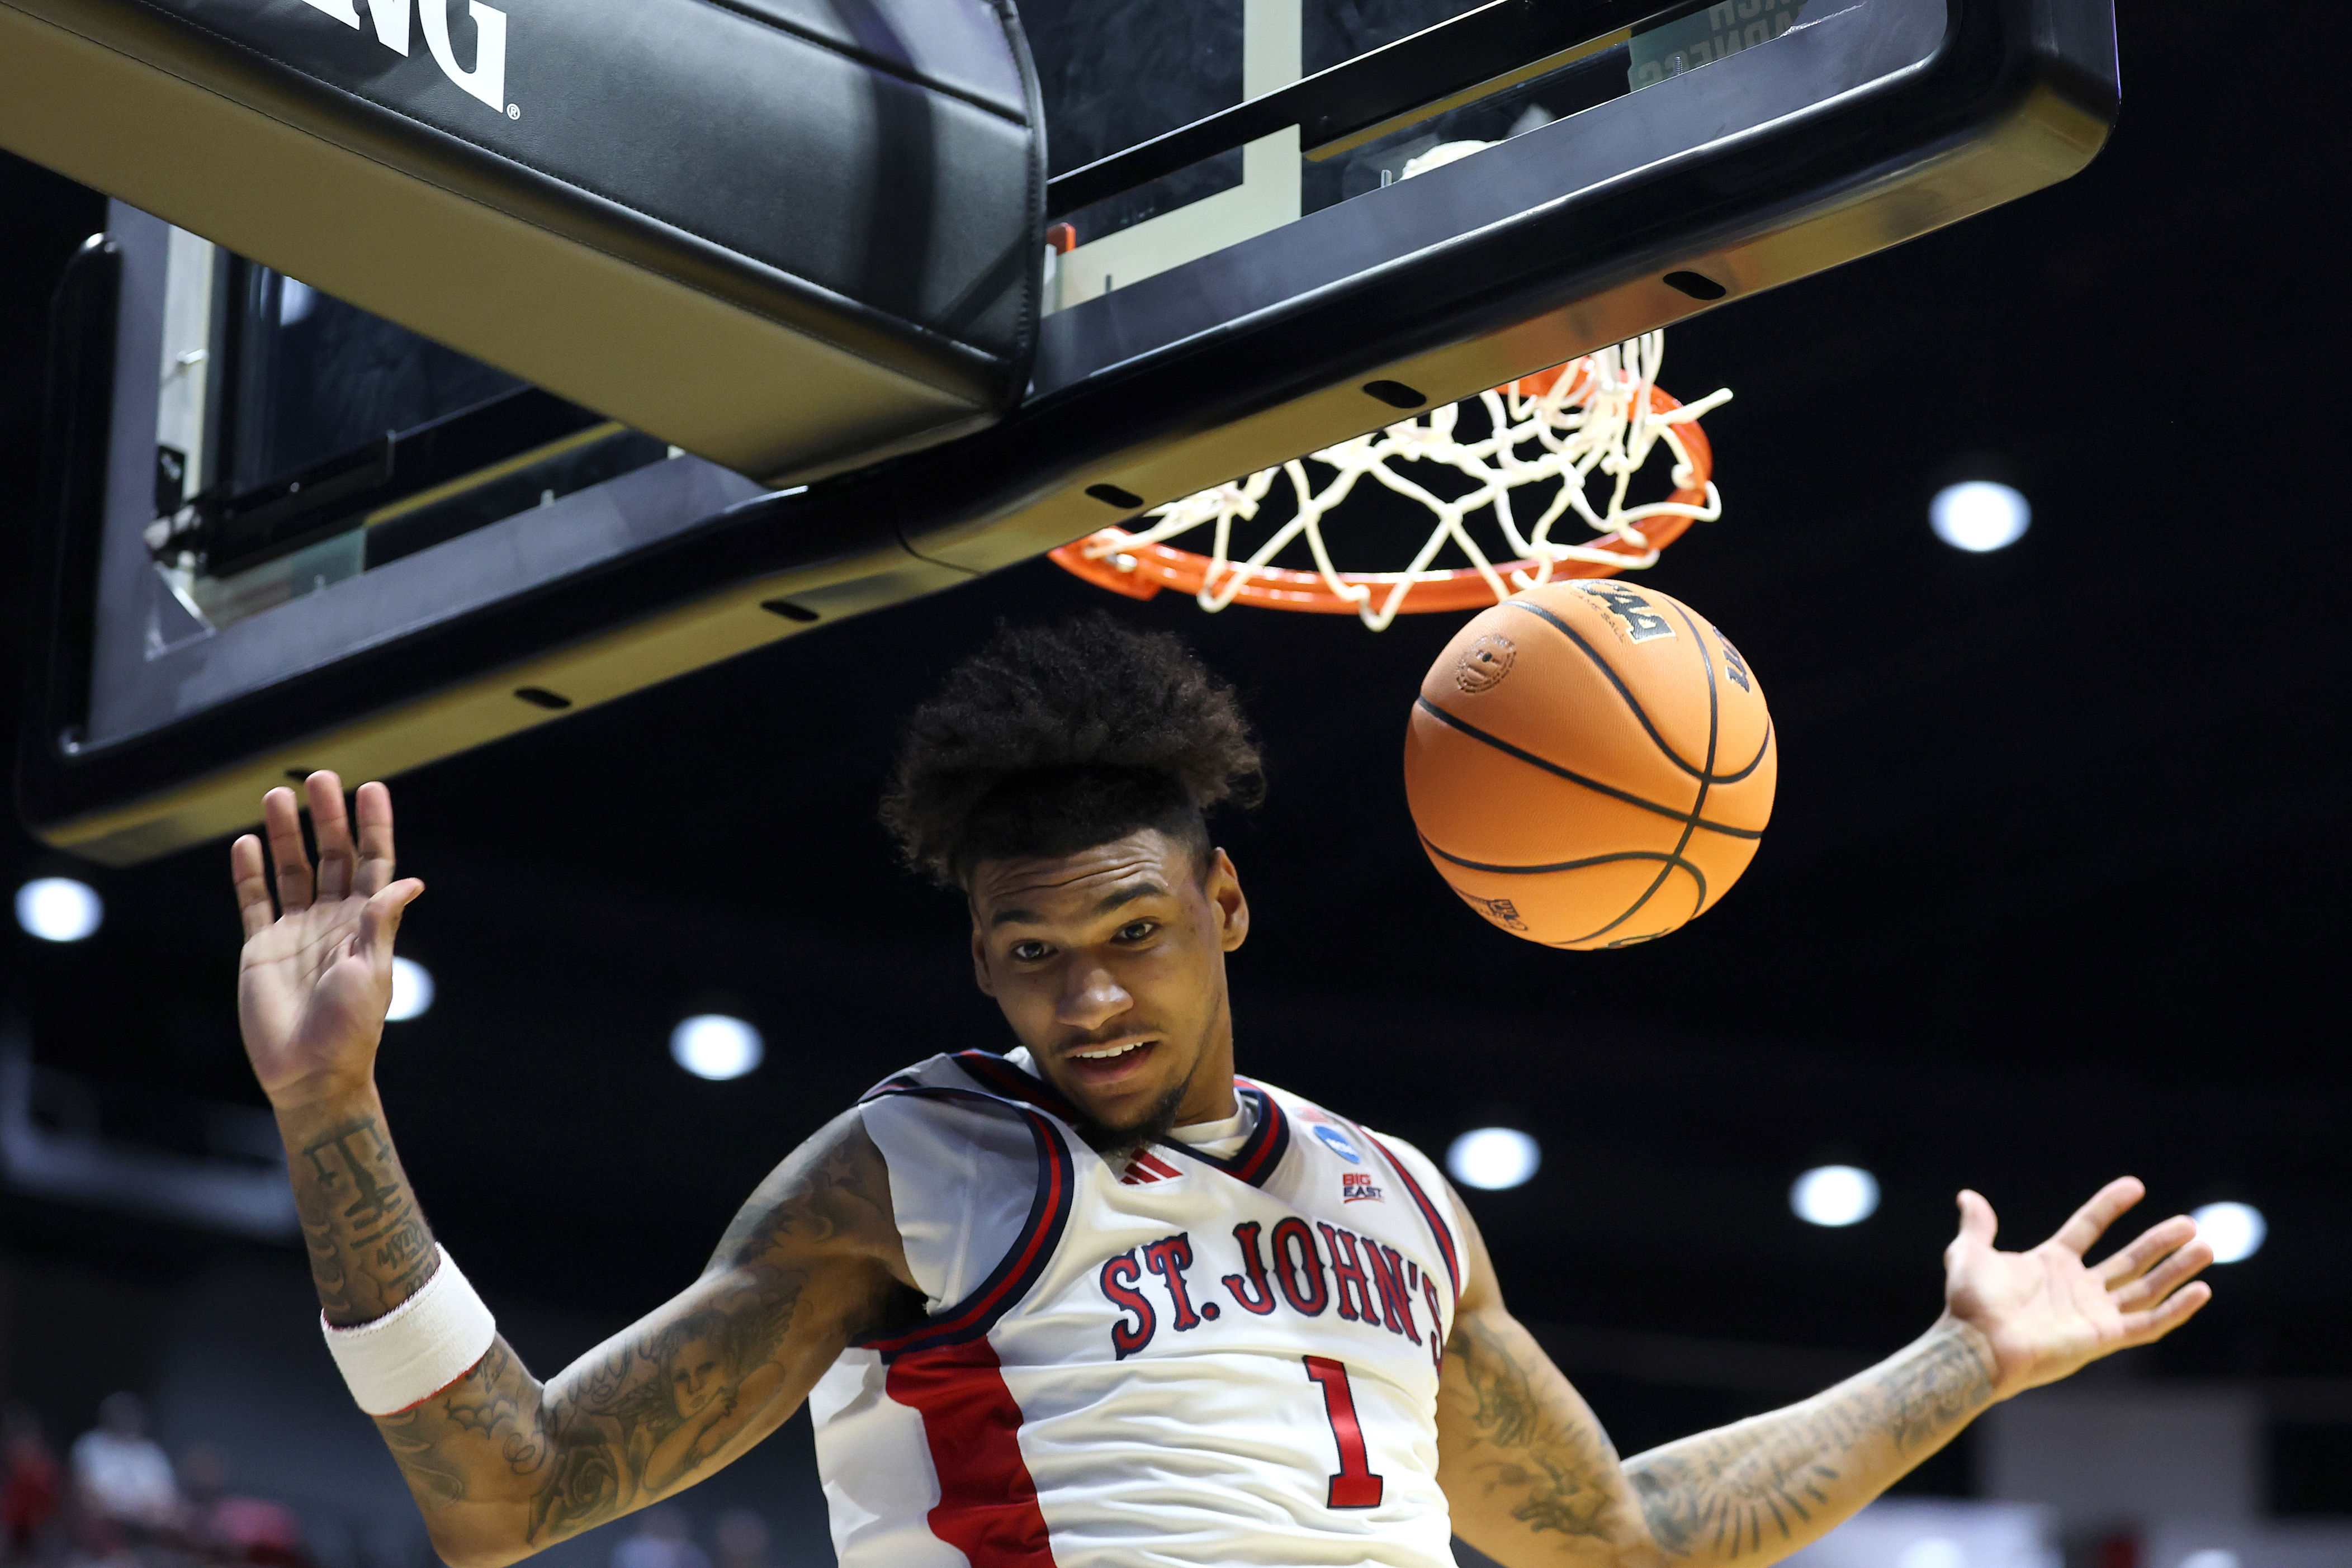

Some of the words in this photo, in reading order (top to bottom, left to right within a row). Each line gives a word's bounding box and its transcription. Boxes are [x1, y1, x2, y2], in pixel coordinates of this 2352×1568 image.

[1342, 1173, 1371, 1186] BIG
[1343, 1186, 1382, 1198] EAST
[1100, 1231, 1220, 1361] ST.
[1222, 1216, 1444, 1379] JOHN'S
[1303, 1354, 1383, 1510] 1
